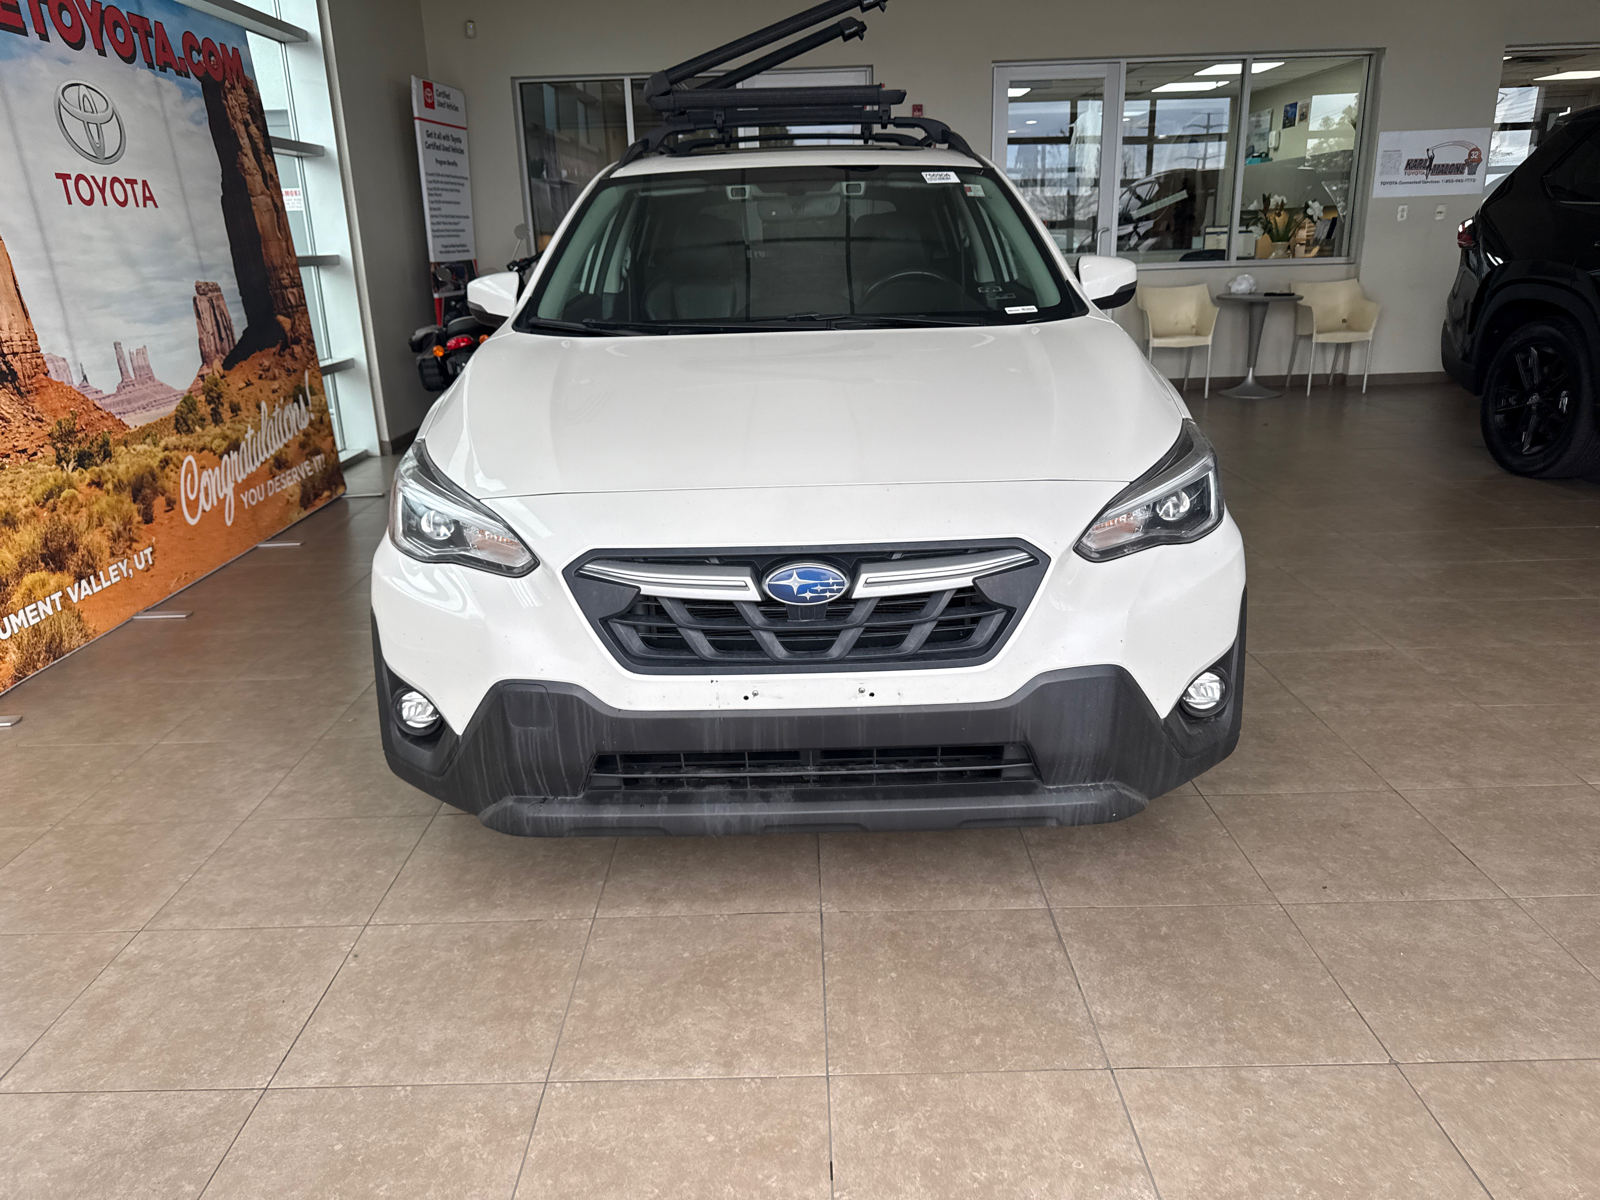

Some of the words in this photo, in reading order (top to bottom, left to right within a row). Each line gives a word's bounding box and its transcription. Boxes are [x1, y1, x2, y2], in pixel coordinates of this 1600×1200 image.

[1404, 158, 1428, 171] KARL
[1469, 151, 1480, 159] 32
[55, 172, 159, 209] TOYOTA
[181, 369, 315, 526] Congratulations!
[240, 483, 265, 509] YOU
[267, 460, 314, 497] DESERVE
[312, 453, 326, 473] IT!
[66, 558, 133, 604] VALLEY,
[133, 546, 154, 571] UT
